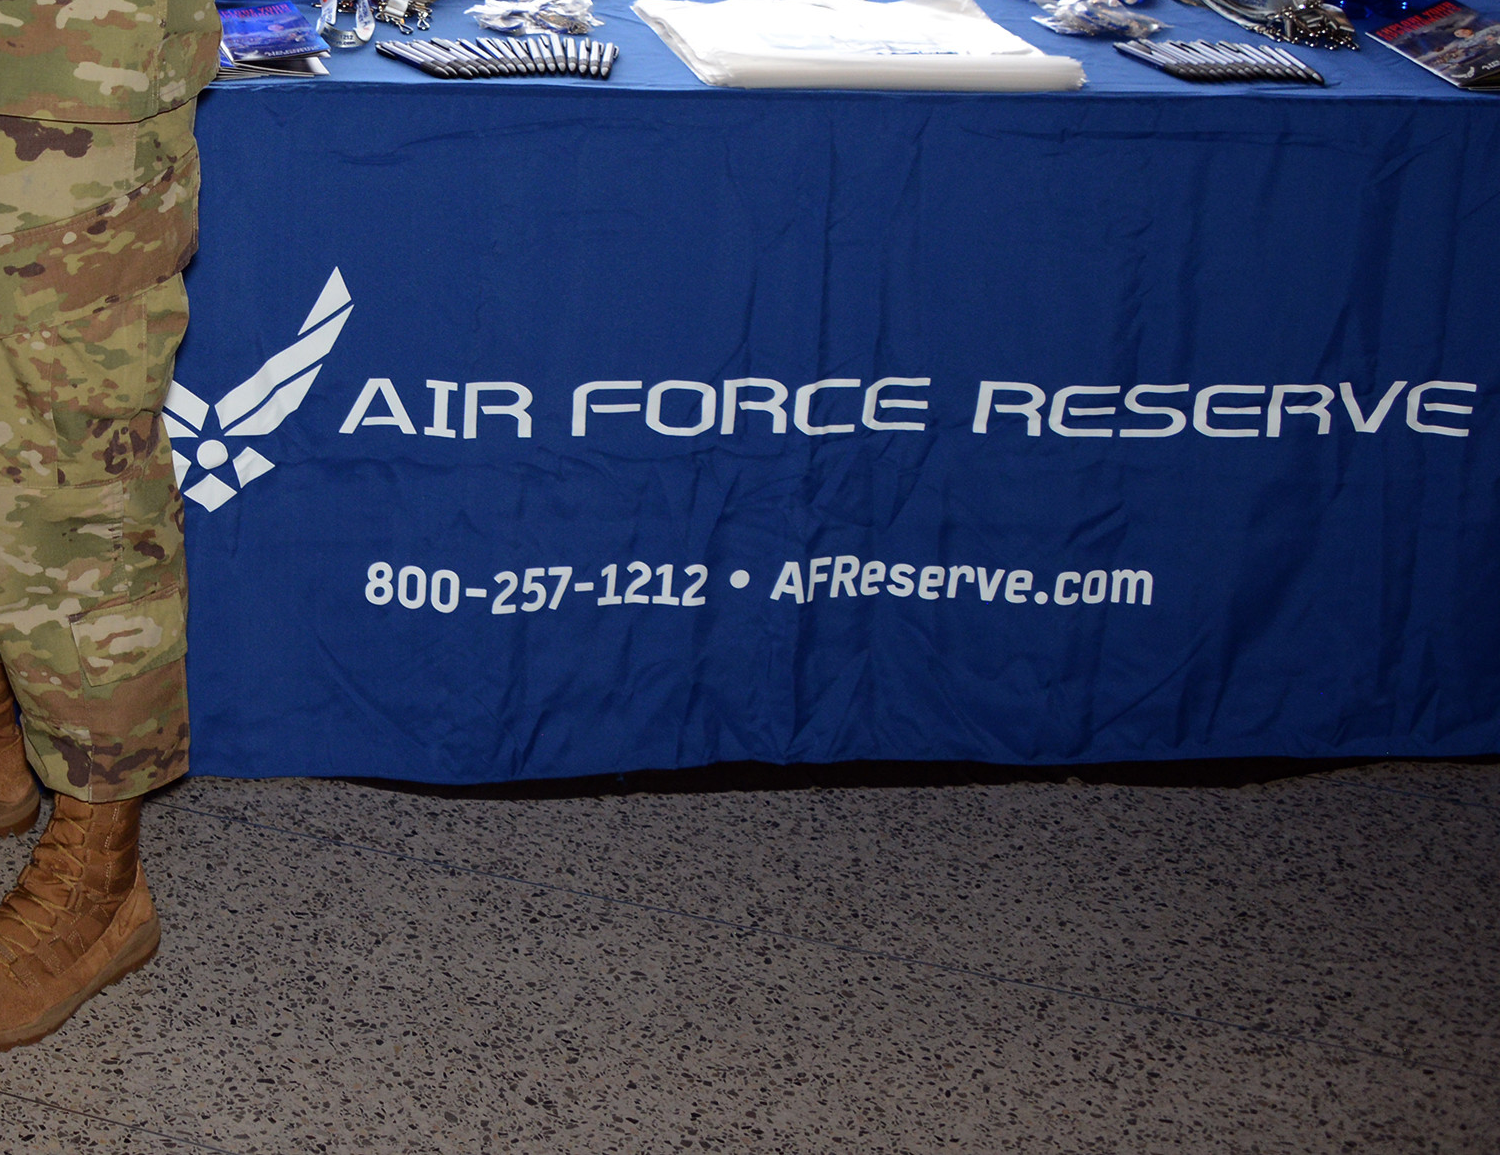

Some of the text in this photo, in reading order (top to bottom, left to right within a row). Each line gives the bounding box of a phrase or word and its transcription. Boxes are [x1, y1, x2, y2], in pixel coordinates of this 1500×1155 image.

[338, 376, 1478, 440] AIR FORCE RESERVE
[365, 555, 1154, 615] 800-257-1212 AFReserve.com
